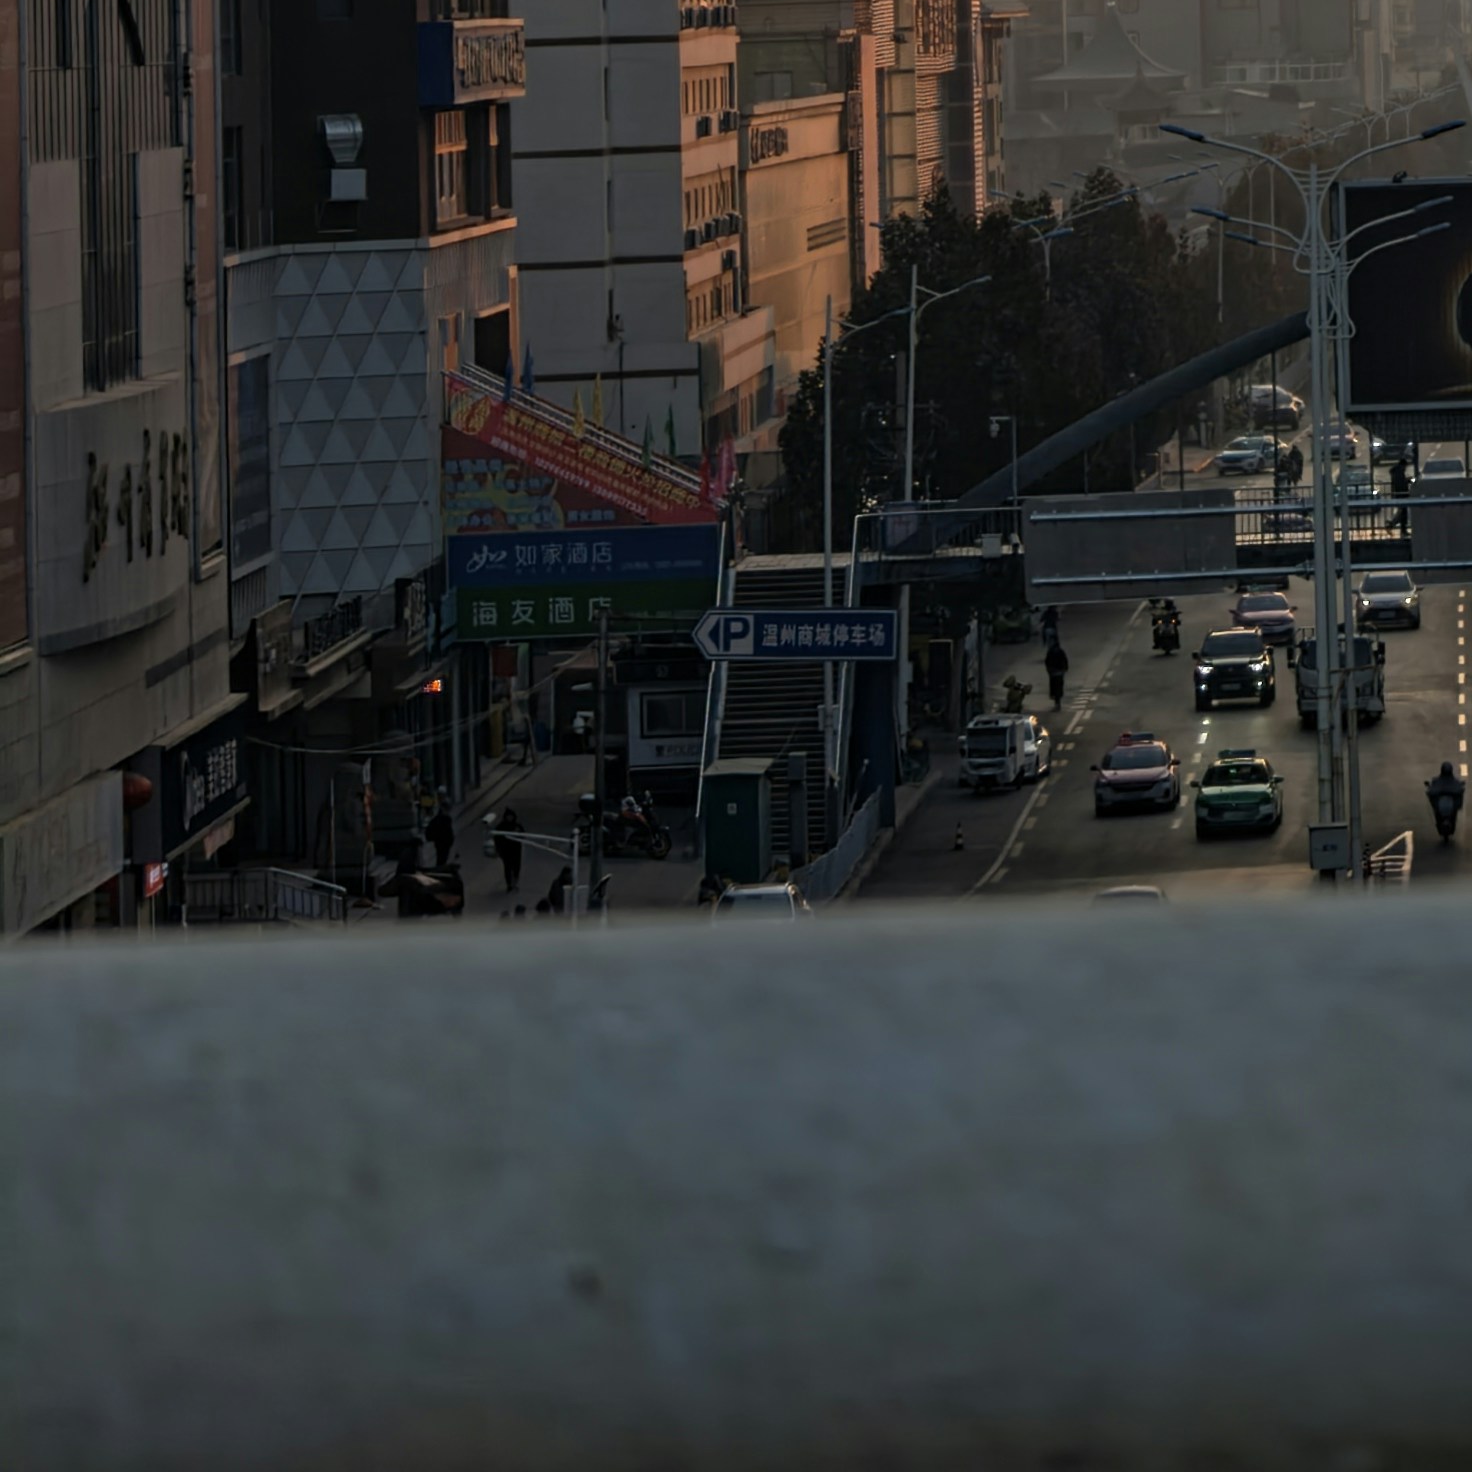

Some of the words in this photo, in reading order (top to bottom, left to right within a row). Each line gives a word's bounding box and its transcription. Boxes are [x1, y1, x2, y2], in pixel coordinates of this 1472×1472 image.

[514, 541, 613, 567] 如家酒店
[472, 596, 613, 628] 海友酒店
[723, 617, 750, 653] P
[761, 622, 887, 649] 温州商城停车场
